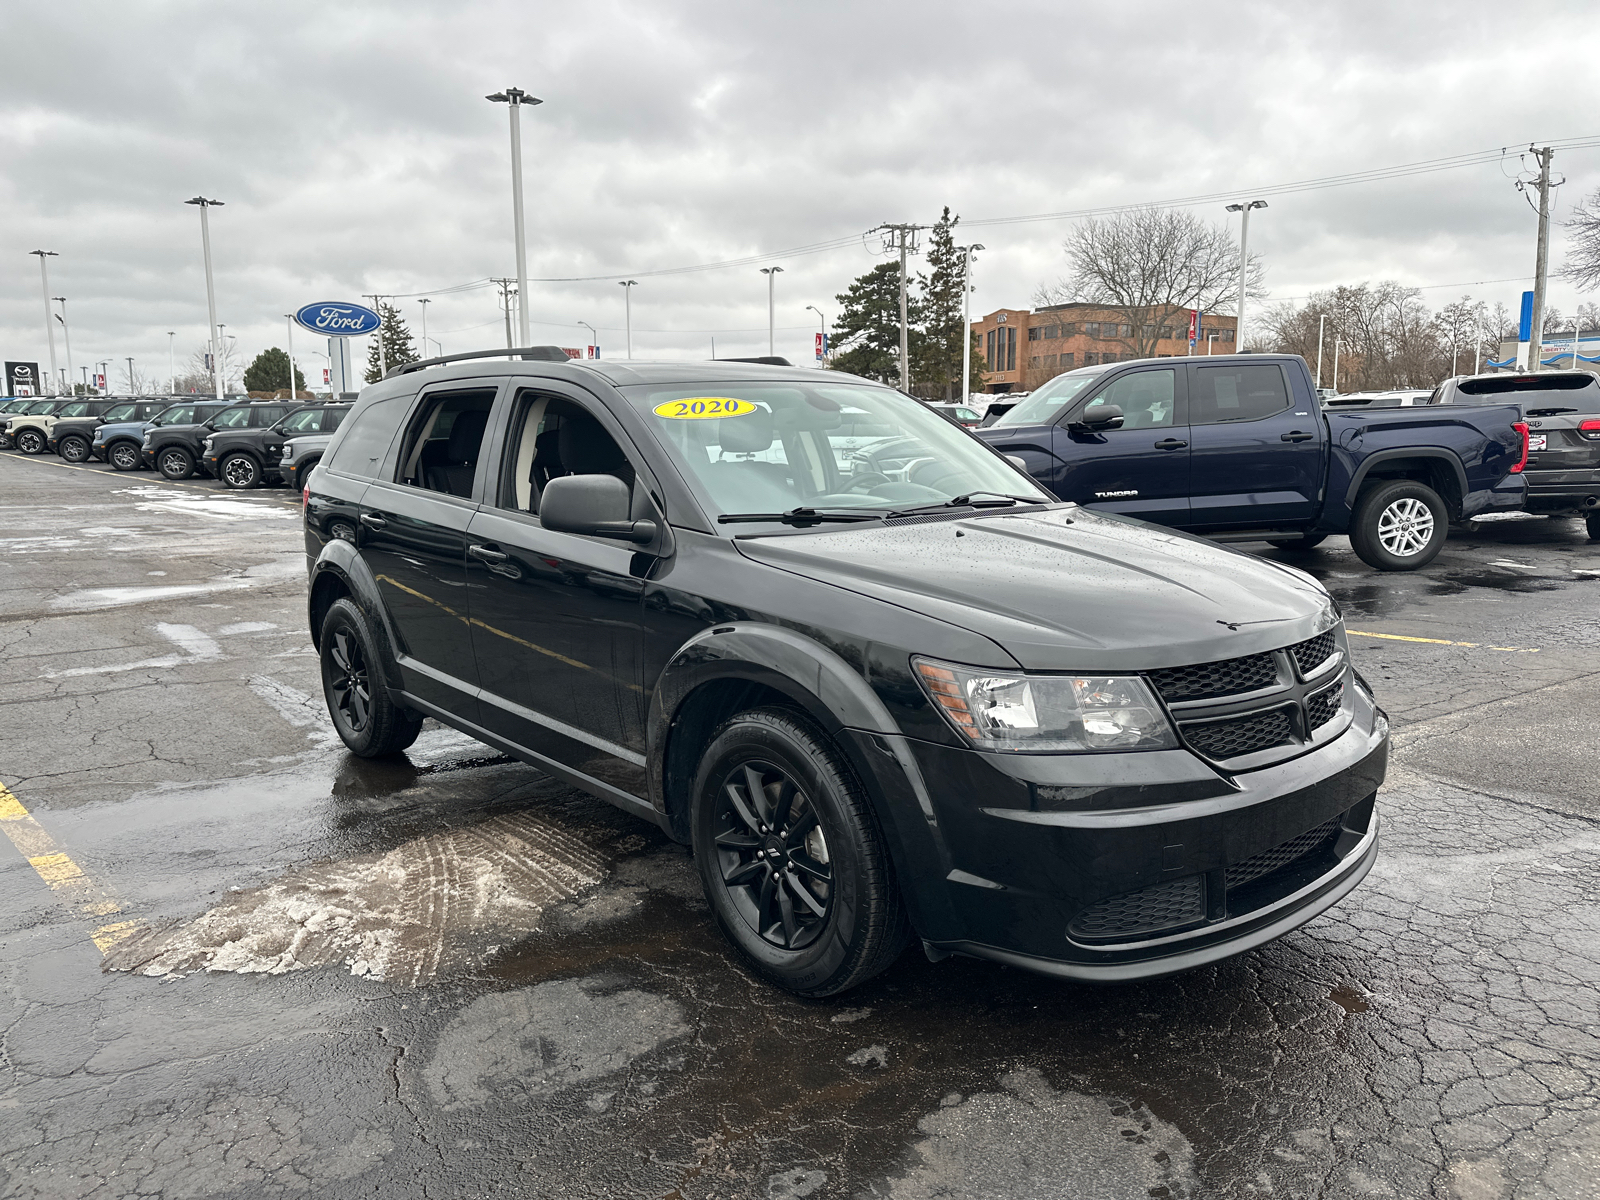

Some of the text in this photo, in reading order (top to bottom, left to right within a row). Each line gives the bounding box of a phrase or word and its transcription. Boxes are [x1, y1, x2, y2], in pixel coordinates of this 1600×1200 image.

[315, 307, 365, 330] Ford
[674, 399, 740, 416] 2020
[1094, 489, 1139, 498] TUNDRA
